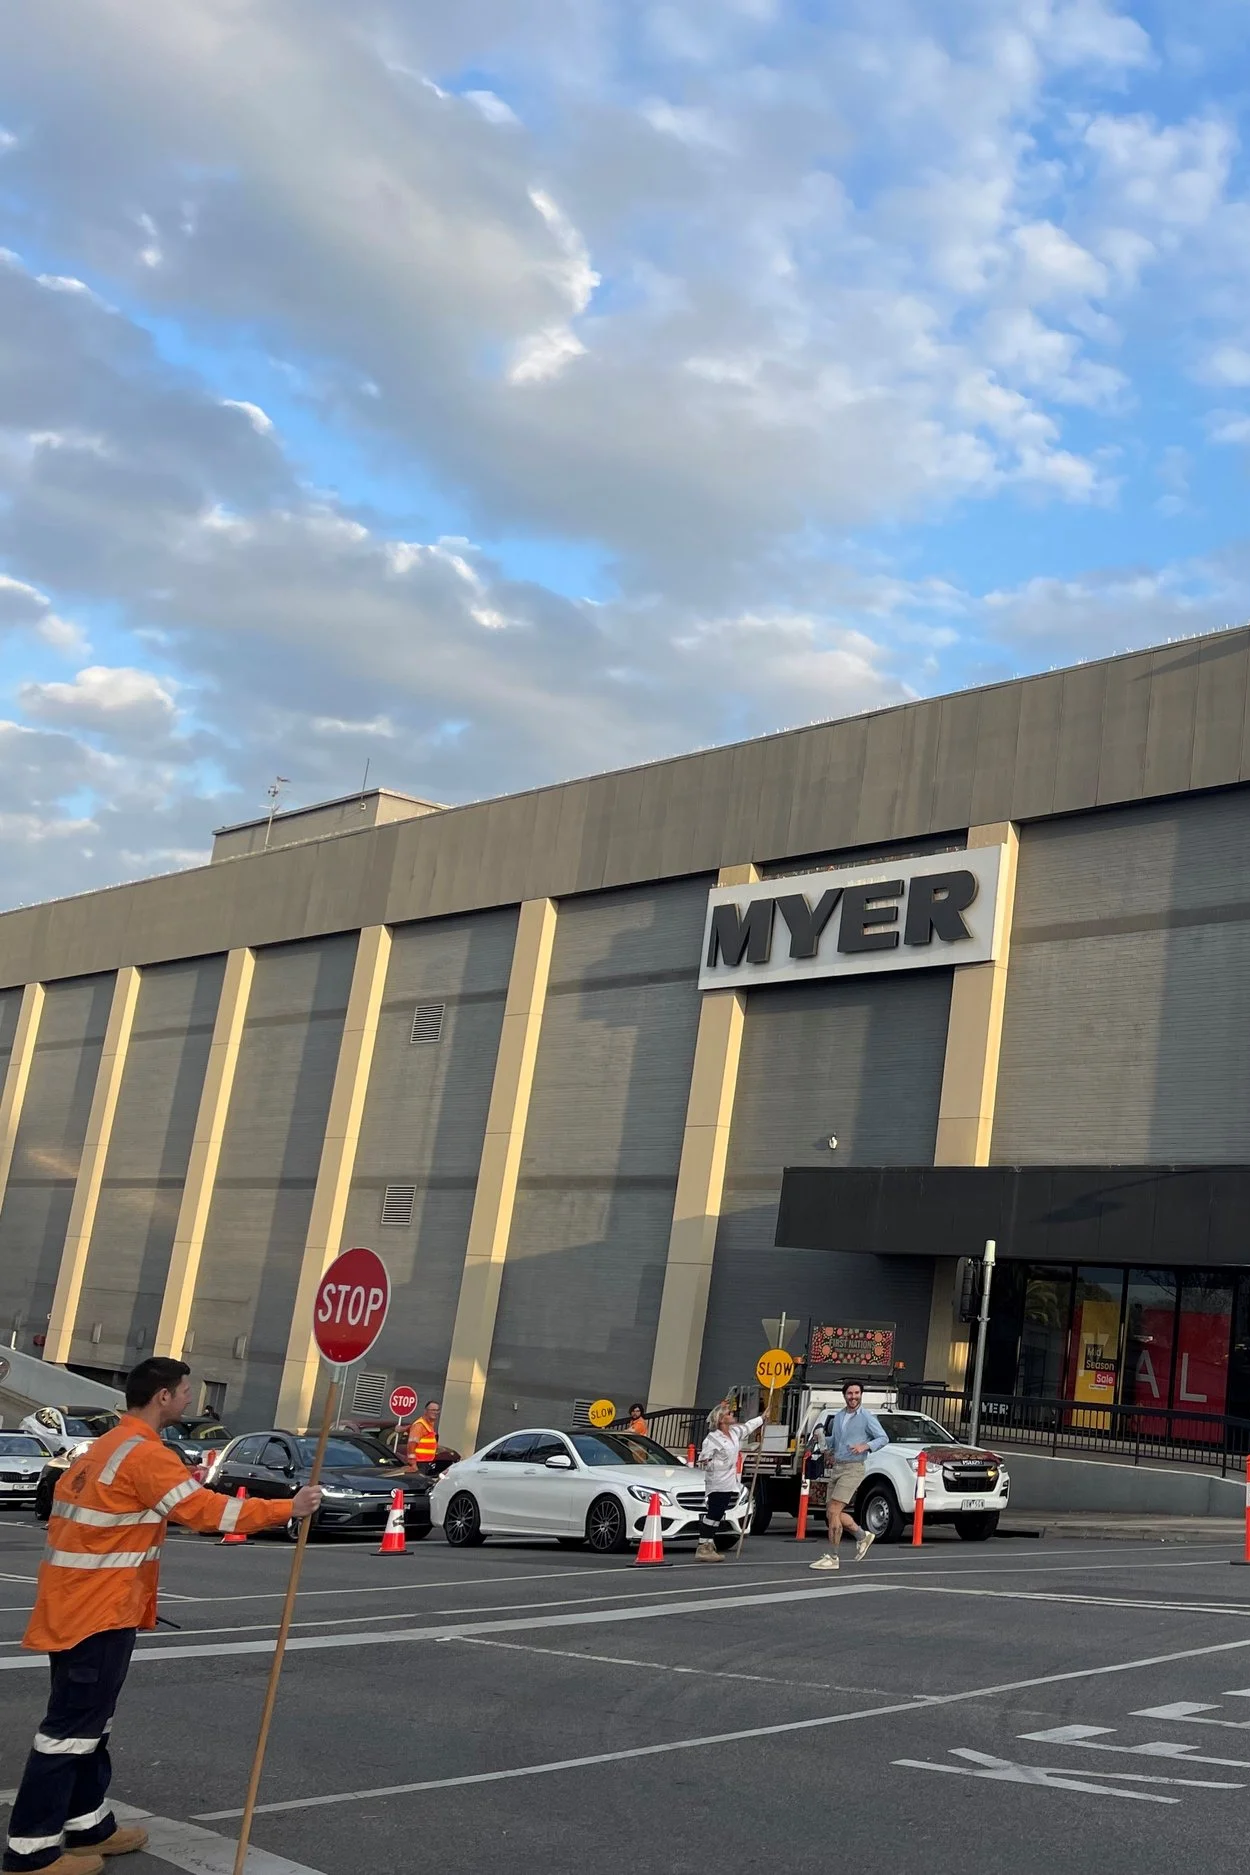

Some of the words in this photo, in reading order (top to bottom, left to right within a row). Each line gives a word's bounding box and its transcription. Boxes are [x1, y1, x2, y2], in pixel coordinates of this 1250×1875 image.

[706, 870, 979, 968] MYER
[318, 1283, 383, 1327] STOP
[829, 1338, 847, 1348] FIRST
[1087, 1347, 1102, 1357] Mid
[757, 1361, 794, 1377] SLOW
[1086, 1359, 1115, 1371] Season
[1096, 1373, 1114, 1384] Sale
[391, 1394, 415, 1407] STOP
[590, 1407, 614, 1420] SLOW
